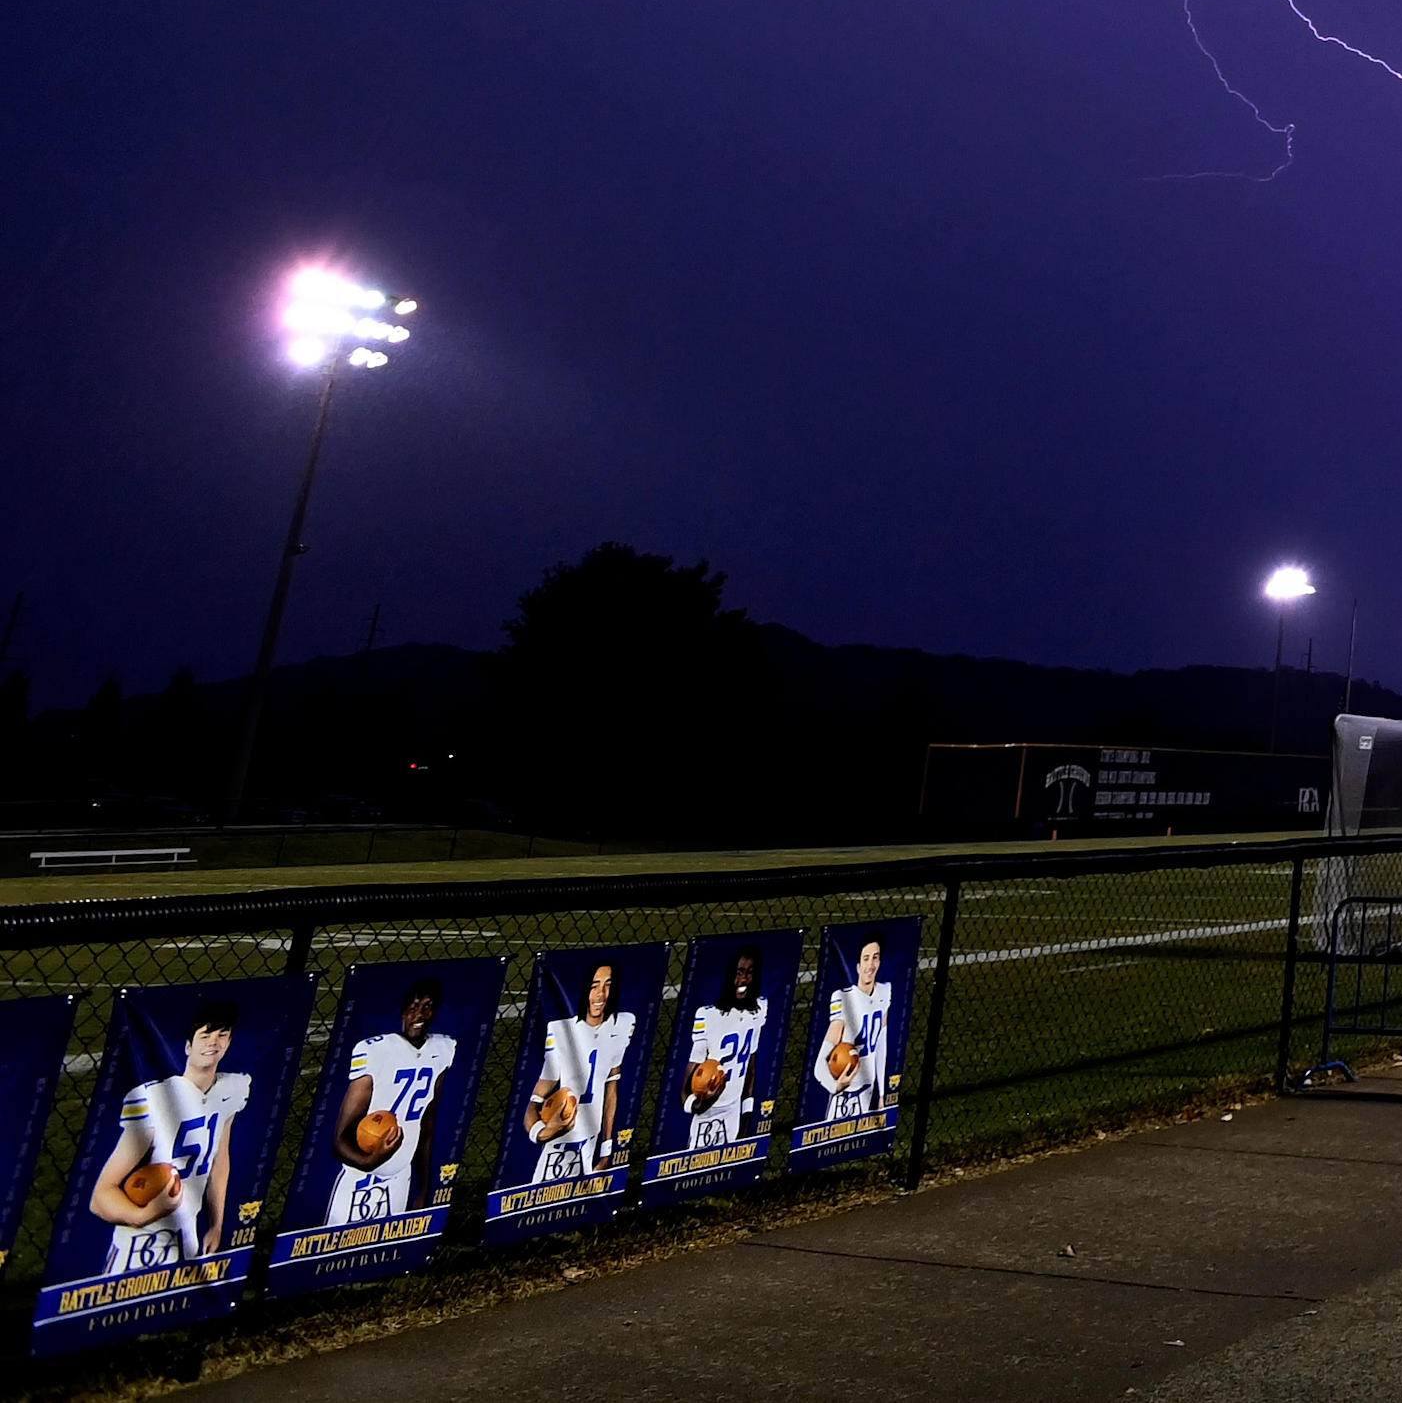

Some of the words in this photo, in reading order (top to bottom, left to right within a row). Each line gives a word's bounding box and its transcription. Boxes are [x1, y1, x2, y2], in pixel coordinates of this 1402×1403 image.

[855, 1010, 882, 1057] 40
[719, 1028, 754, 1081] 24
[391, 1067, 433, 1121] 72
[579, 1049, 598, 1104] 1
[171, 1112, 219, 1179] 51
[801, 1125, 831, 1146] BATTLE
[817, 1138, 867, 1158] FOOTBALL
[657, 1156, 690, 1178] BATTLE
[689, 1150, 720, 1171] GROUND
[720, 1142, 757, 1164] ACADEMY
[500, 1189, 536, 1214] BATTLE
[535, 1182, 573, 1205] GROUND
[674, 1170, 733, 1191] FOOTBALL
[517, 1204, 588, 1228] FOOTBALL
[231, 1225, 257, 1246] 2026
[291, 1231, 339, 1258] BATTLE
[338, 1224, 380, 1248] GROUND
[380, 1214, 433, 1241] ACADEMY
[315, 1249, 401, 1275] FOOTBALL
[59, 1281, 117, 1314] BATTLE
[115, 1270, 170, 1300] GROUND
[88, 1296, 192, 1331] FOOTBALL
